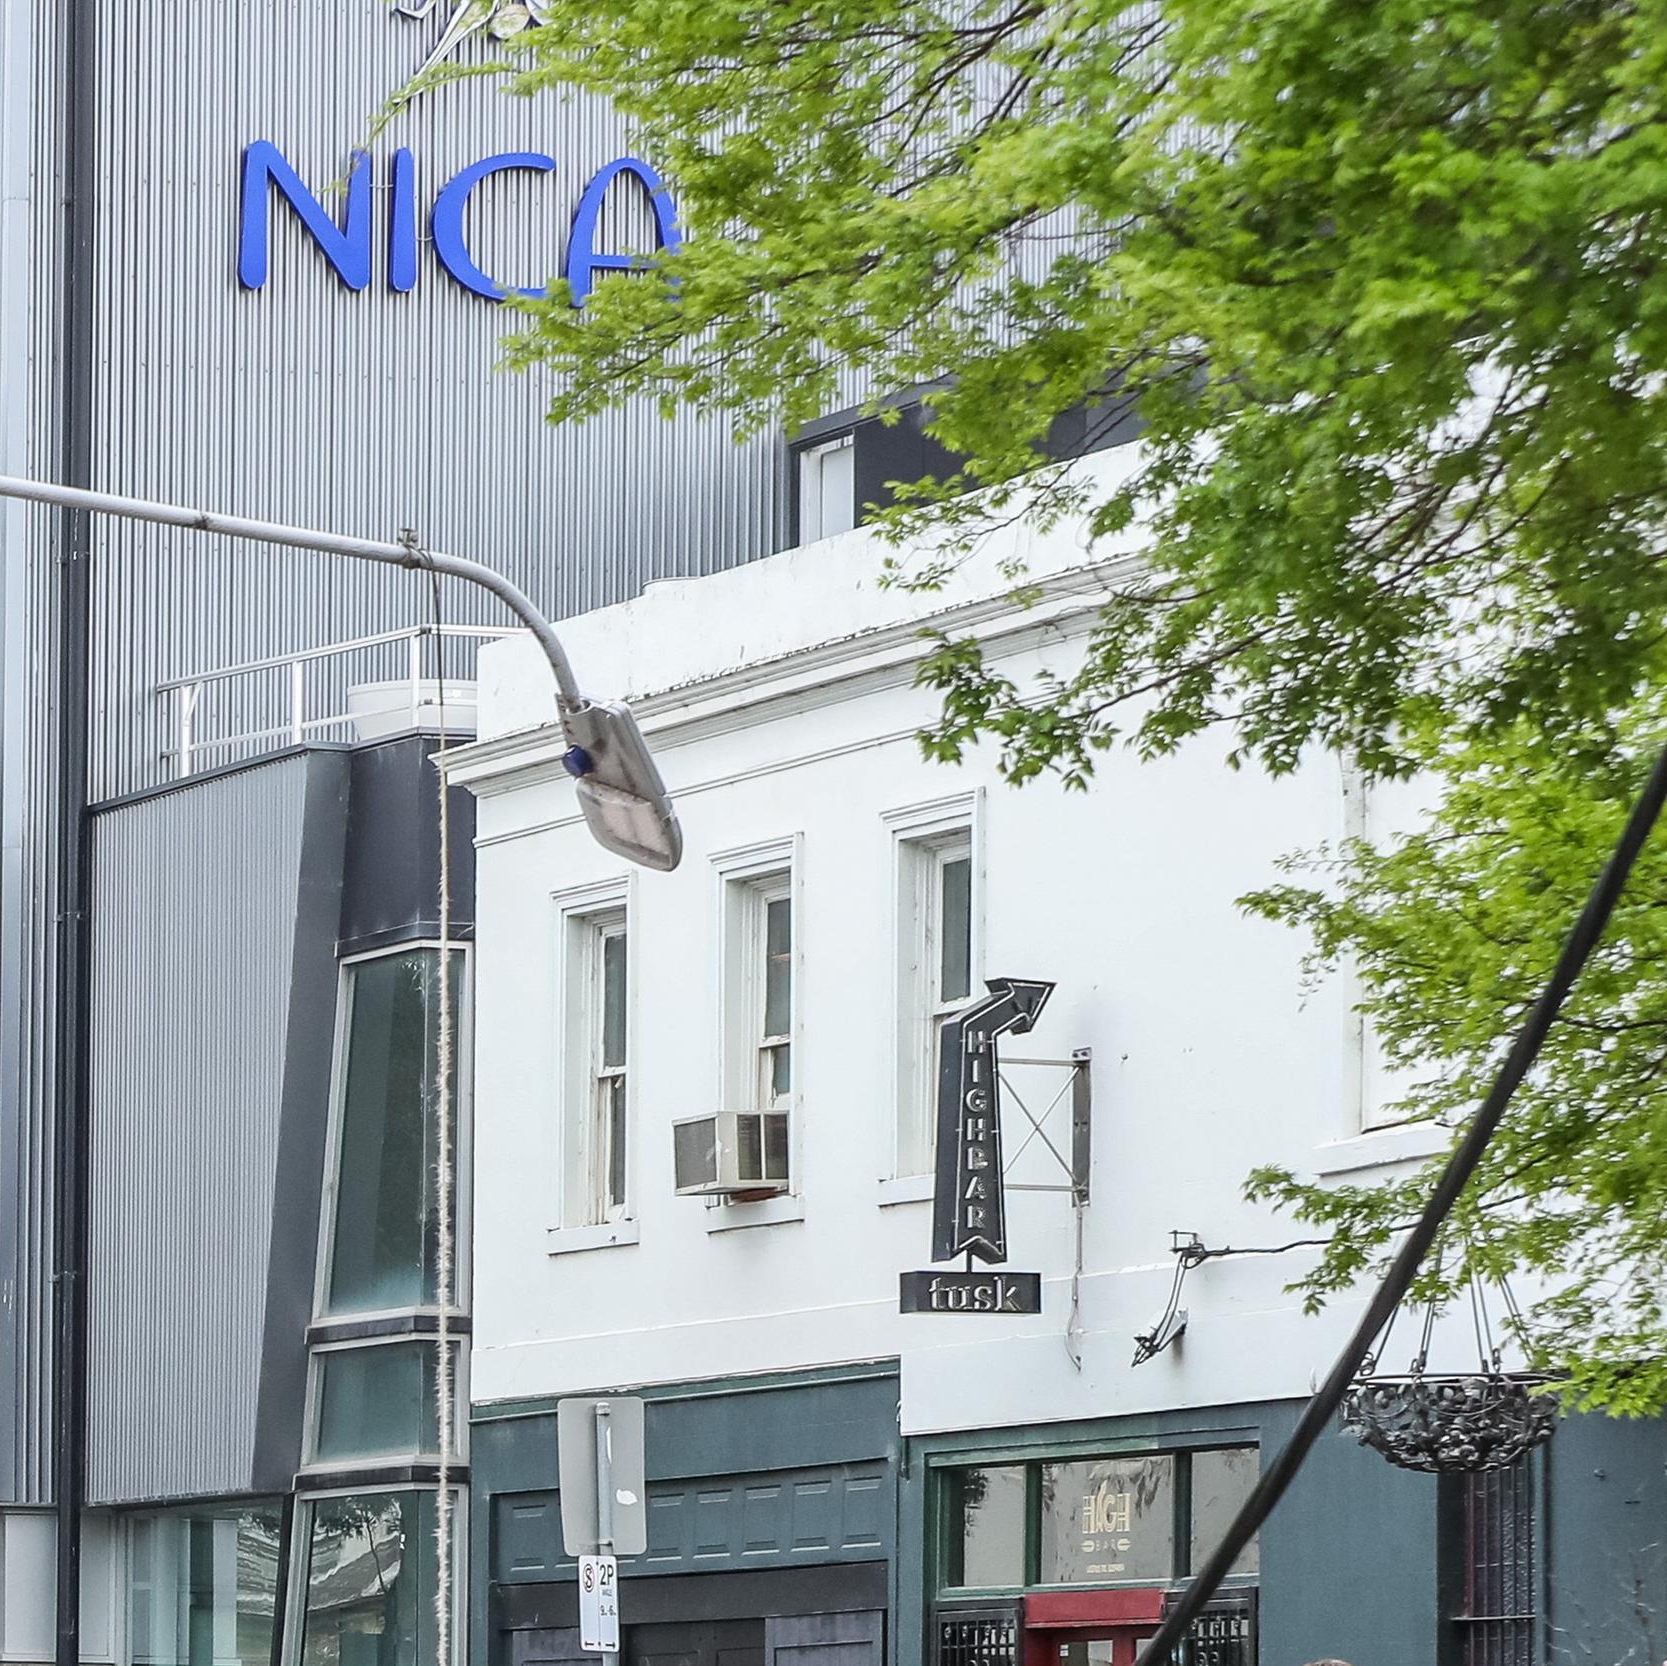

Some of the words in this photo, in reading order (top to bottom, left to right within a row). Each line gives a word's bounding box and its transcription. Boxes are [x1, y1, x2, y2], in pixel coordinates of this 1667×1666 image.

[238, 138, 683, 308] NICA
[928, 1276, 1021, 1312] tusk
[1082, 1479, 1132, 1535] HIGH
[600, 1564, 614, 1586] 2P
